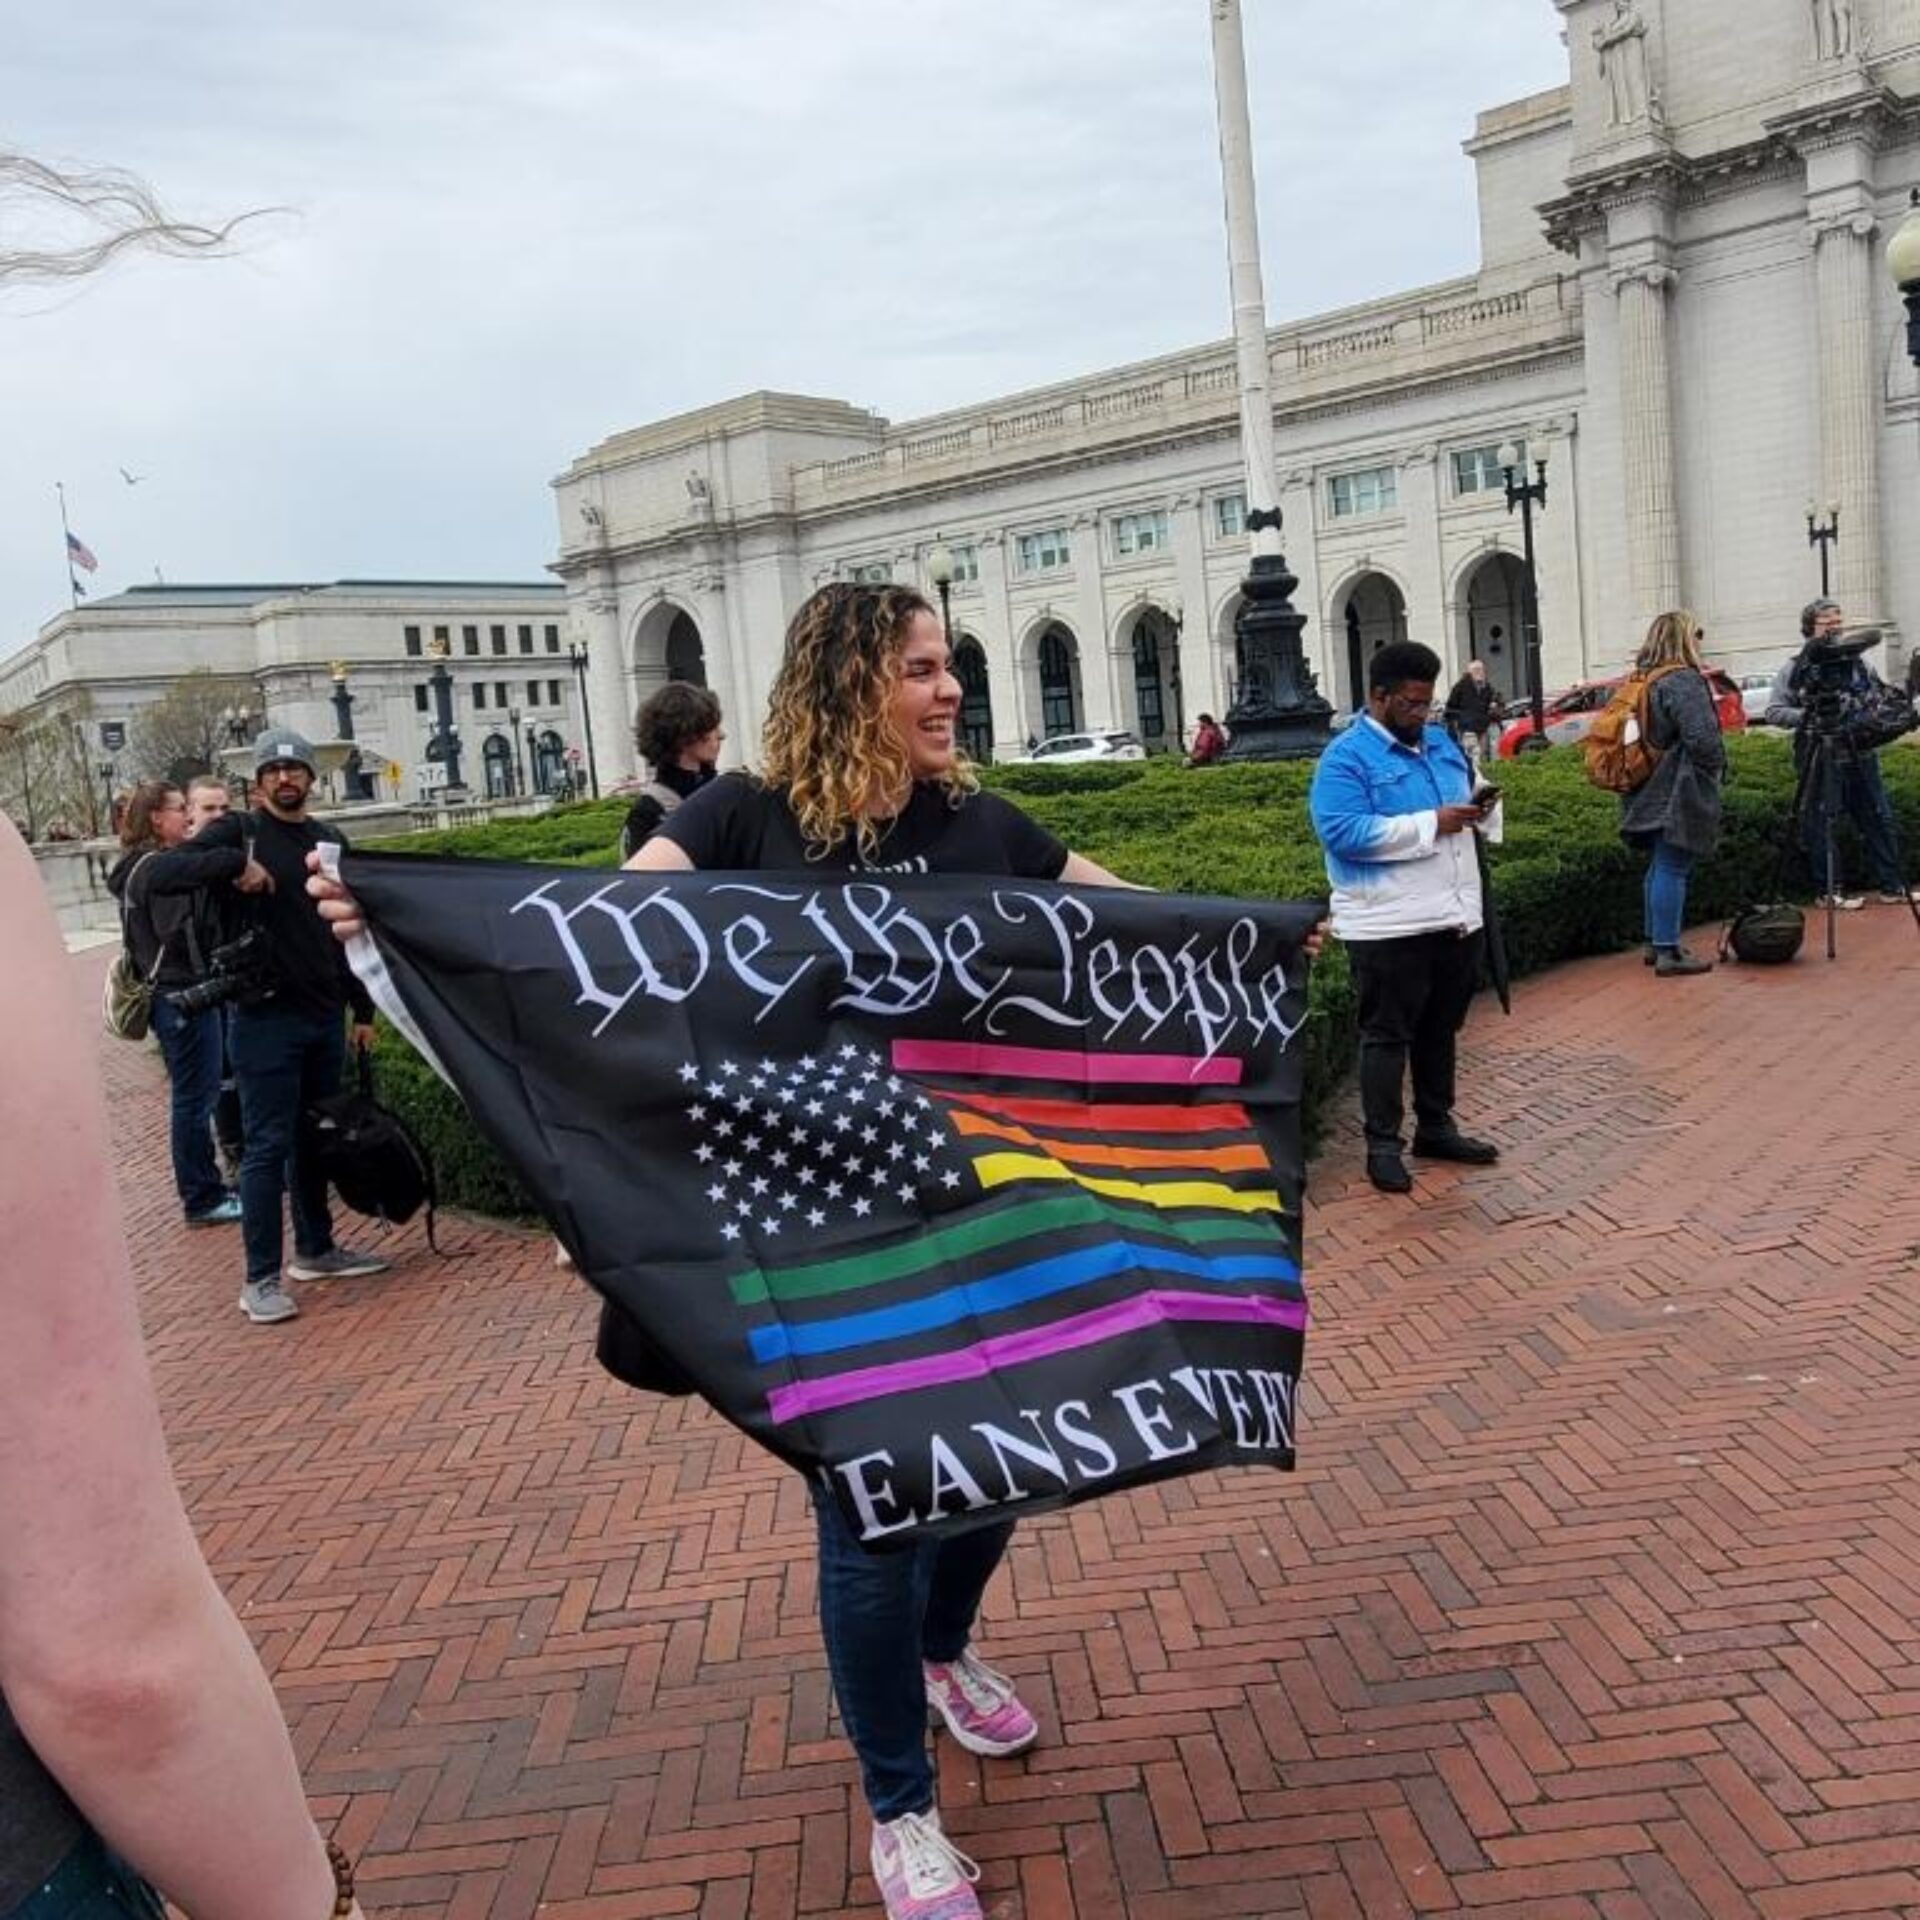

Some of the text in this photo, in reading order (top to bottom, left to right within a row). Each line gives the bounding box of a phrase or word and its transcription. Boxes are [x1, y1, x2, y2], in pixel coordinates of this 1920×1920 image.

[509, 879, 815, 1038] We
[986, 891, 1309, 1080] People
[817, 1399, 1118, 1541] EANS
